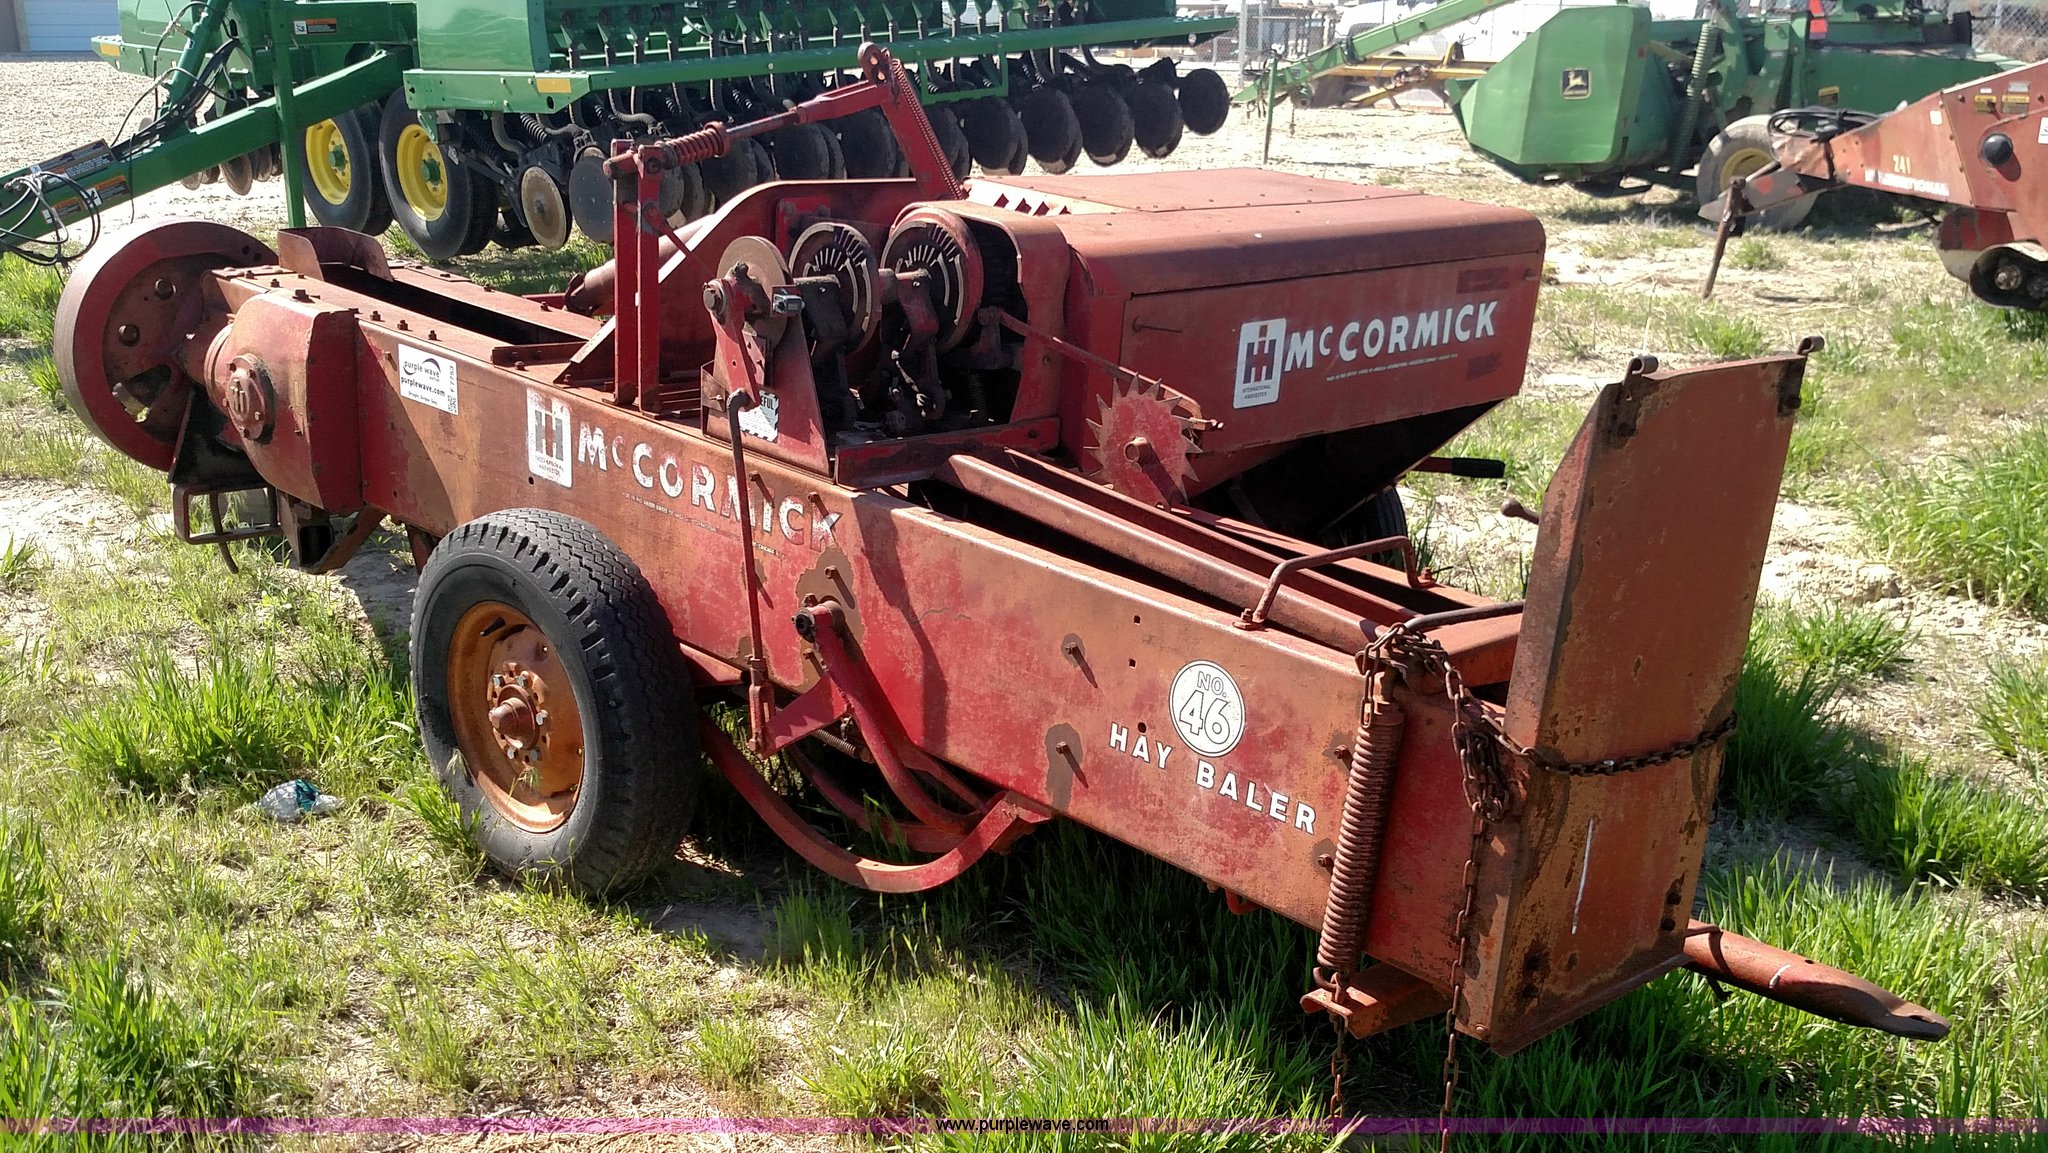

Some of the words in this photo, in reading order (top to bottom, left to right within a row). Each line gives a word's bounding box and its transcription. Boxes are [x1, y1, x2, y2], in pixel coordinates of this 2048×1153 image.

[1892, 154, 1911, 174] 241
[404, 360, 423, 373] purple
[424, 367, 440, 378] wave
[401, 376, 446, 397] purplewave.com
[760, 395, 775, 411] EFUL
[1179, 689, 1231, 745] 46
[1109, 721, 1174, 770] HAY
[1196, 758, 1317, 836] BALER
